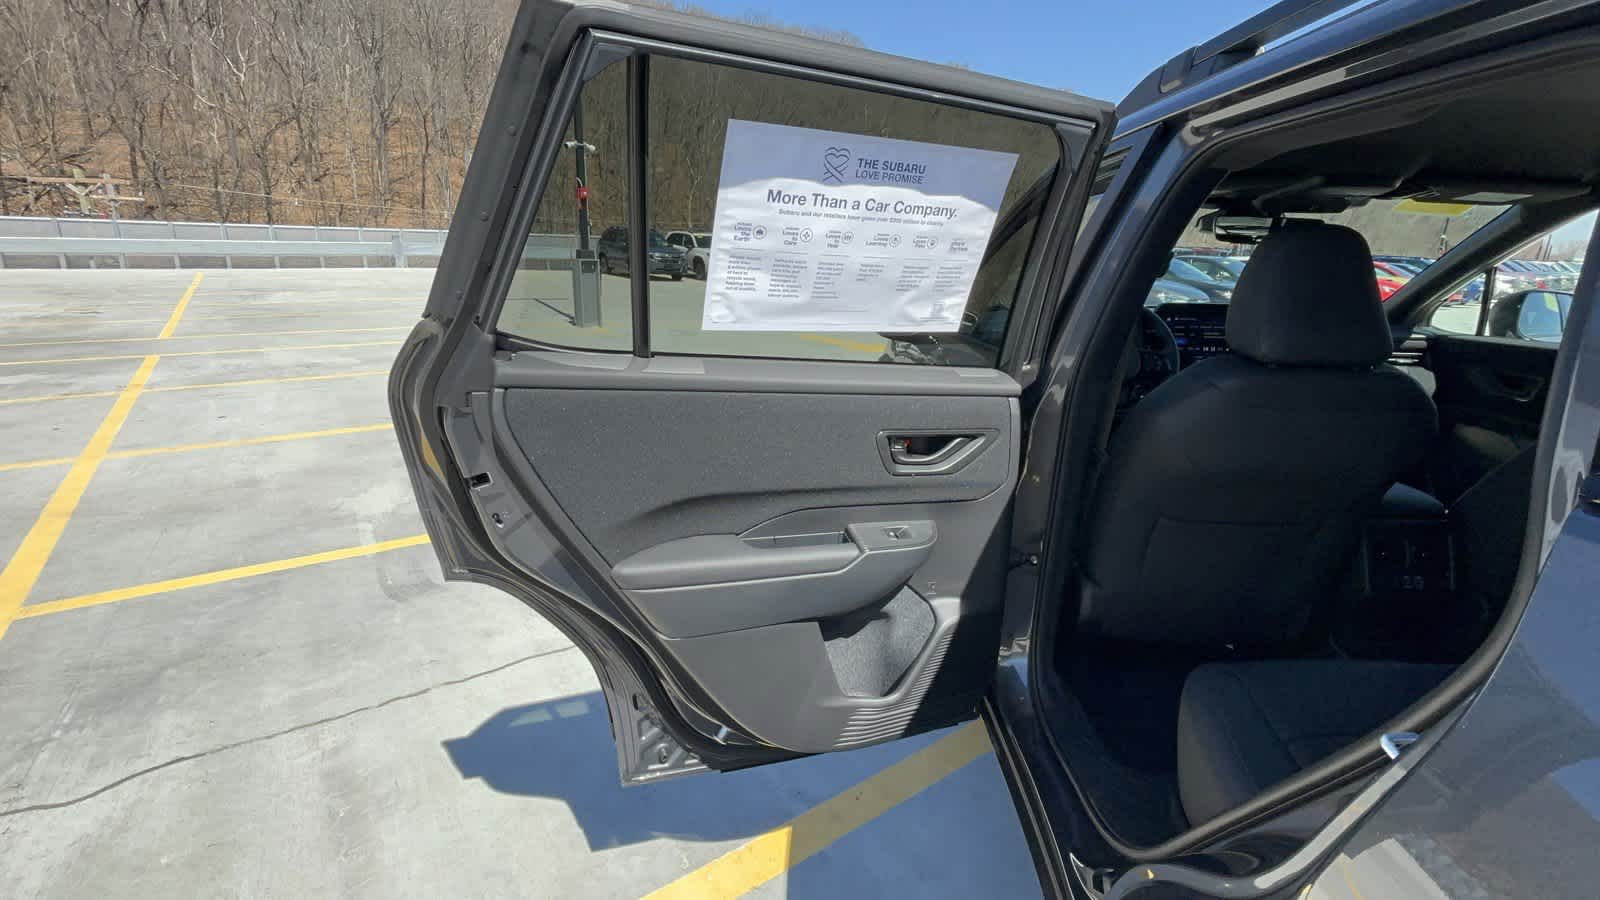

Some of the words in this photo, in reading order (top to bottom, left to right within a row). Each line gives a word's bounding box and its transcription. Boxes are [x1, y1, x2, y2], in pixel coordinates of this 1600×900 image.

[858, 158, 879, 170] THE
[882, 160, 928, 175] SUBARU
[855, 169, 880, 180] LOVE
[882, 172, 925, 185] PROMISE
[767, 189, 807, 207] More
[812, 193, 848, 209] Than
[851, 198, 860, 211] a
[865, 198, 890, 213] Car
[893, 200, 958, 220] Company.
